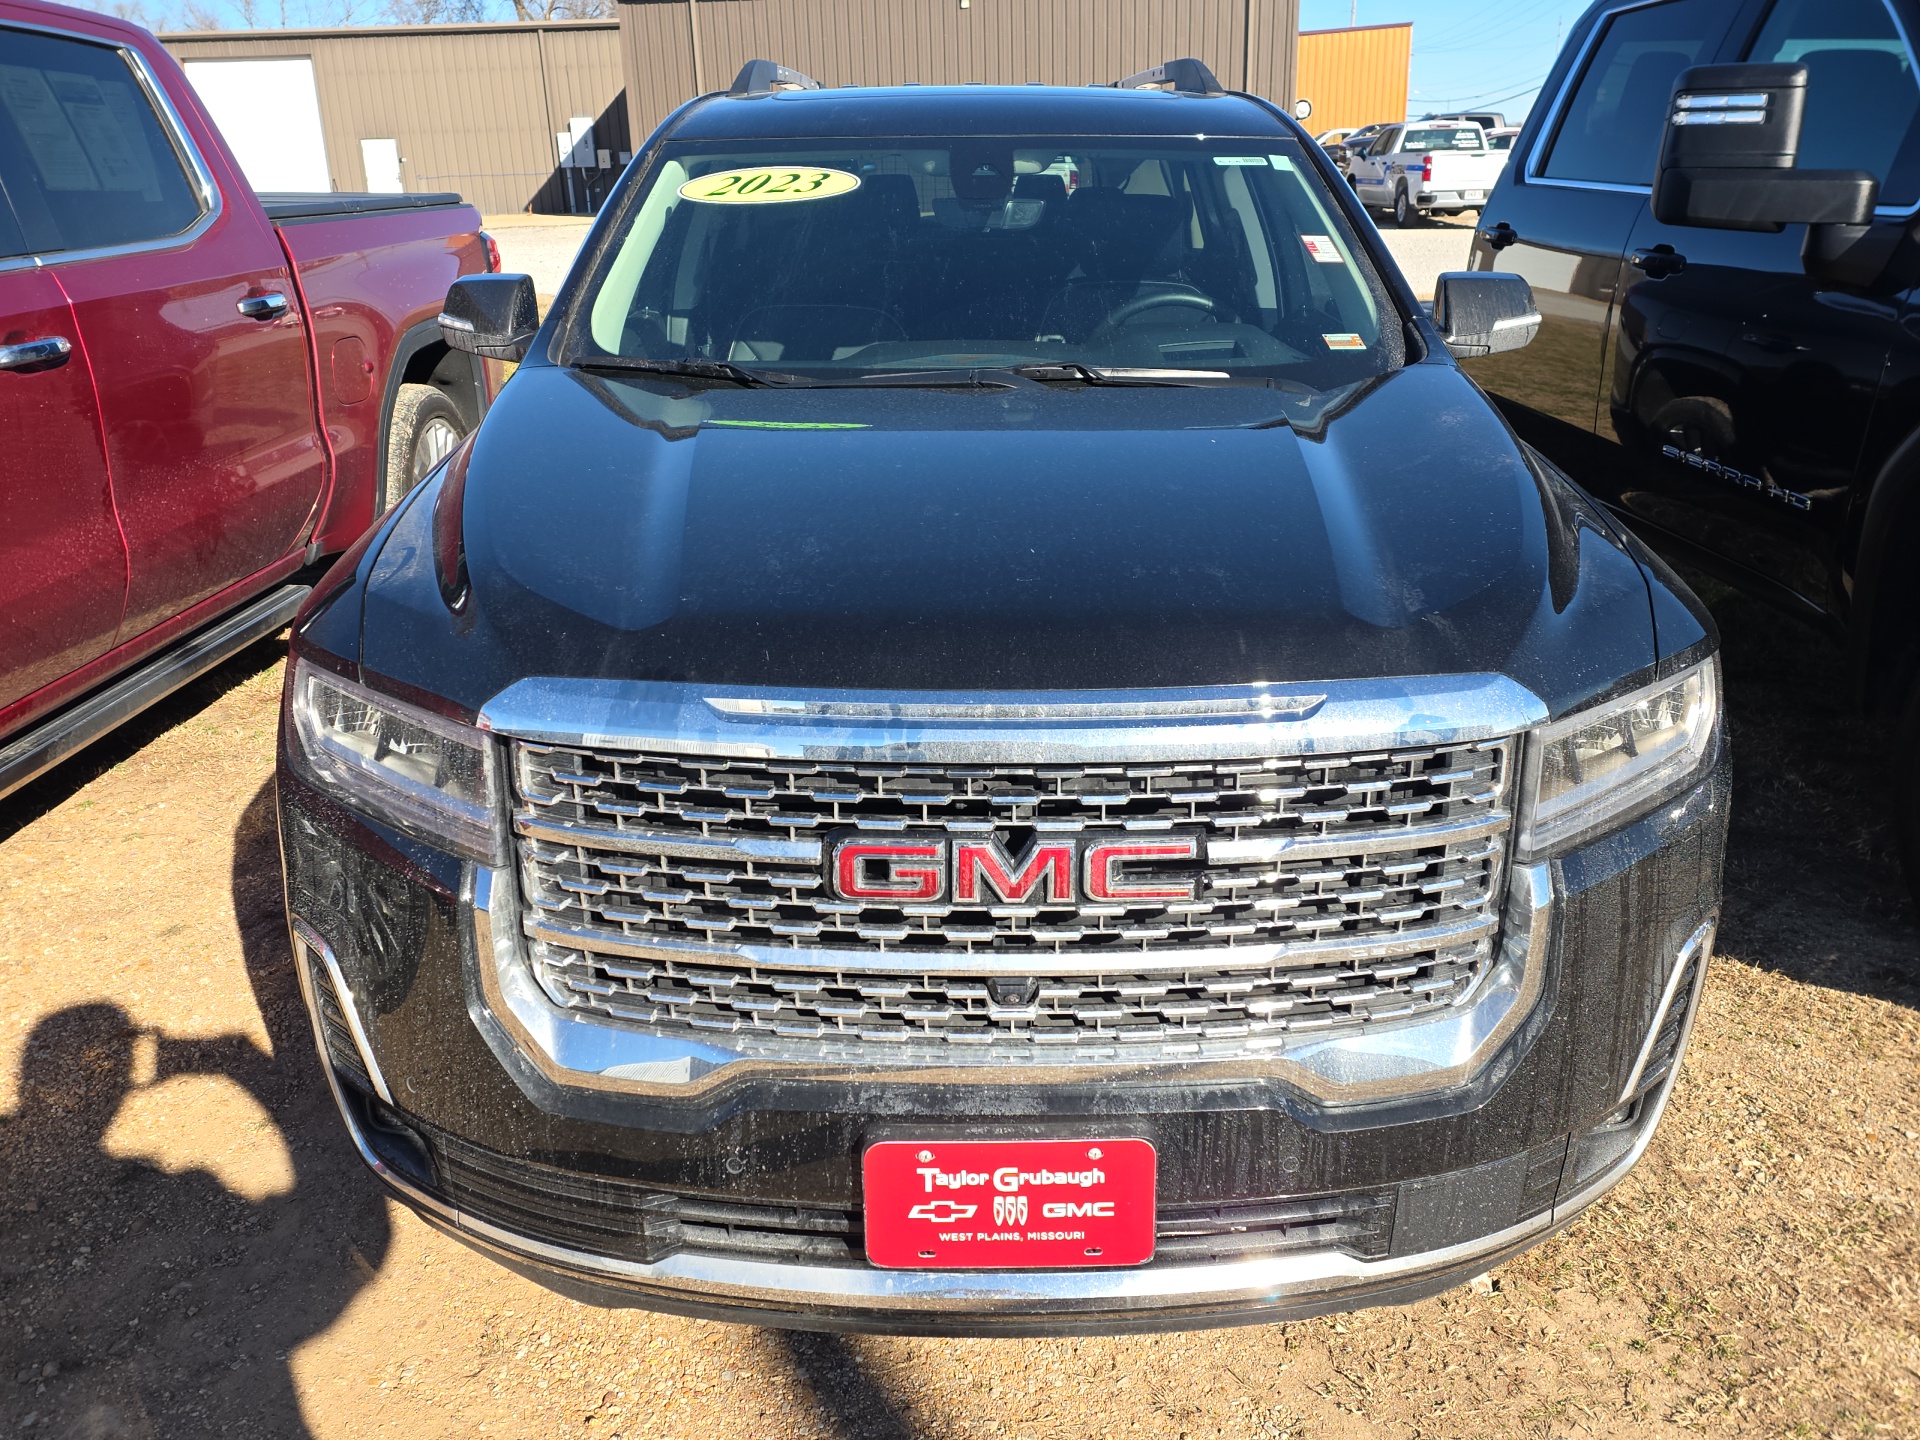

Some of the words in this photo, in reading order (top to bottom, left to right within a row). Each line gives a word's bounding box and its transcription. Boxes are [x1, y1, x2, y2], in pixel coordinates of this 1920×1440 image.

[703, 173, 831, 196] 2023
[1662, 444, 1762, 491] SIERRA
[1768, 483, 1811, 511] HD
[833, 838, 1197, 903] GMC
[916, 1167, 989, 1192] Taylor
[993, 1167, 1105, 1192] Grubaugh
[1042, 1202, 1115, 1217] GMC
[939, 1232, 974, 1242] WEST
[977, 1232, 1024, 1242] PLAINS,
[1027, 1231, 1085, 1240] MISSOURI
